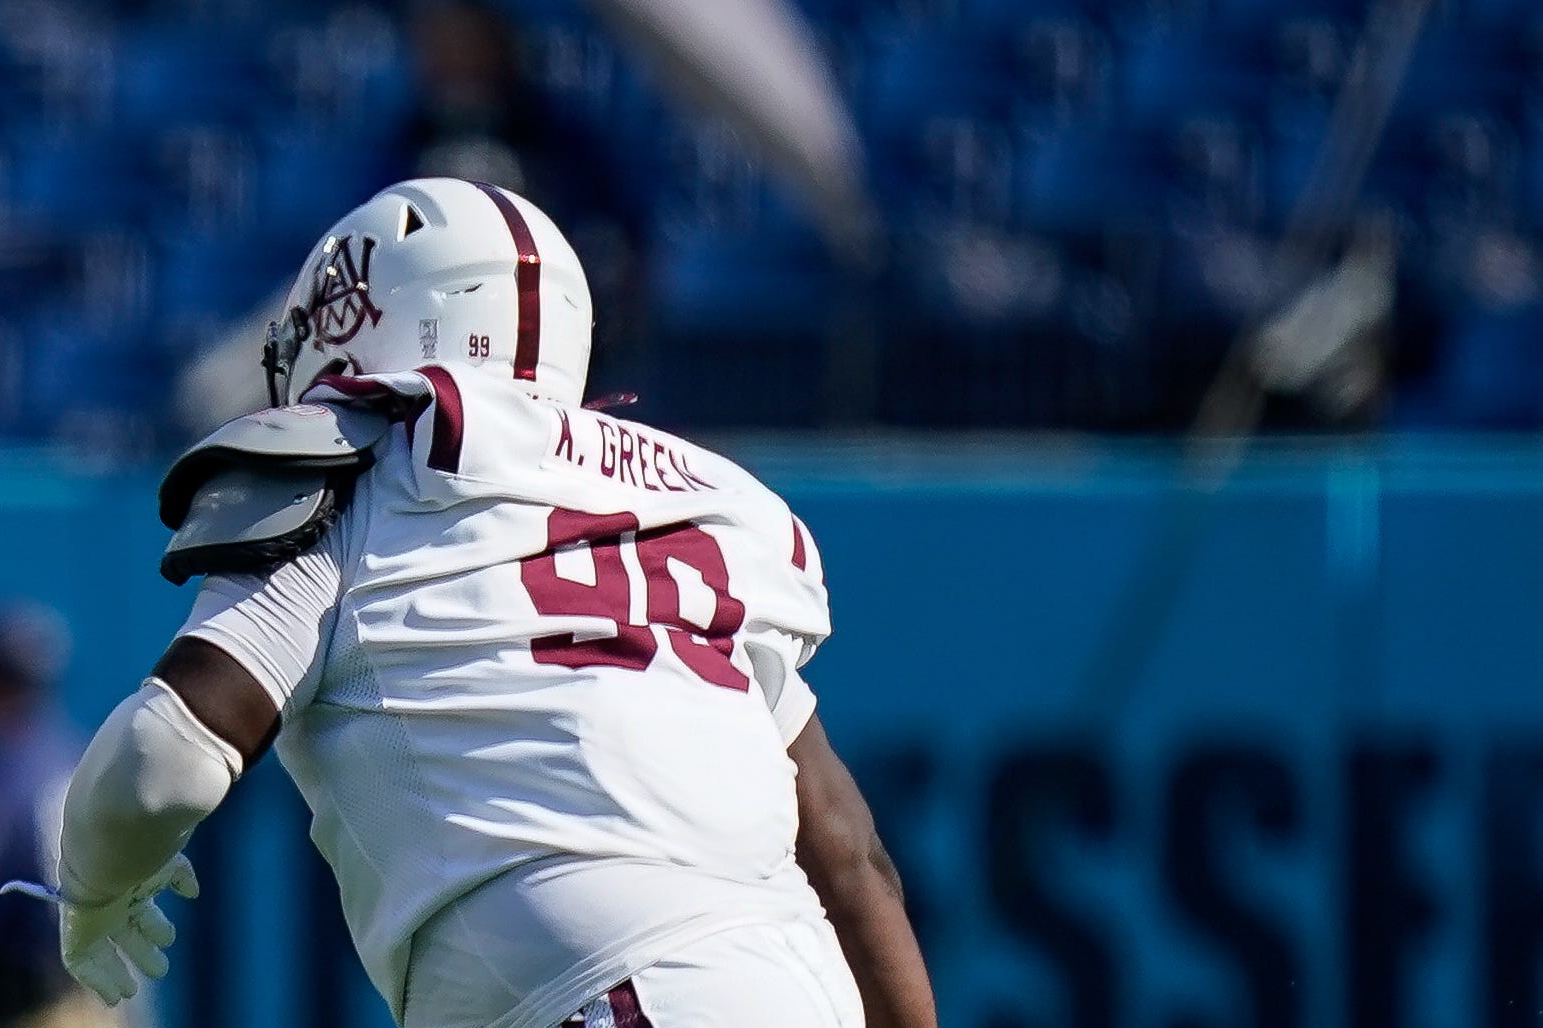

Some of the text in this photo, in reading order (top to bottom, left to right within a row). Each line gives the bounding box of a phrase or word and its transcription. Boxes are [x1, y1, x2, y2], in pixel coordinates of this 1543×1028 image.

[469, 333, 490, 357] 99
[597, 418, 718, 492] GREEN
[520, 506, 750, 694] 99
